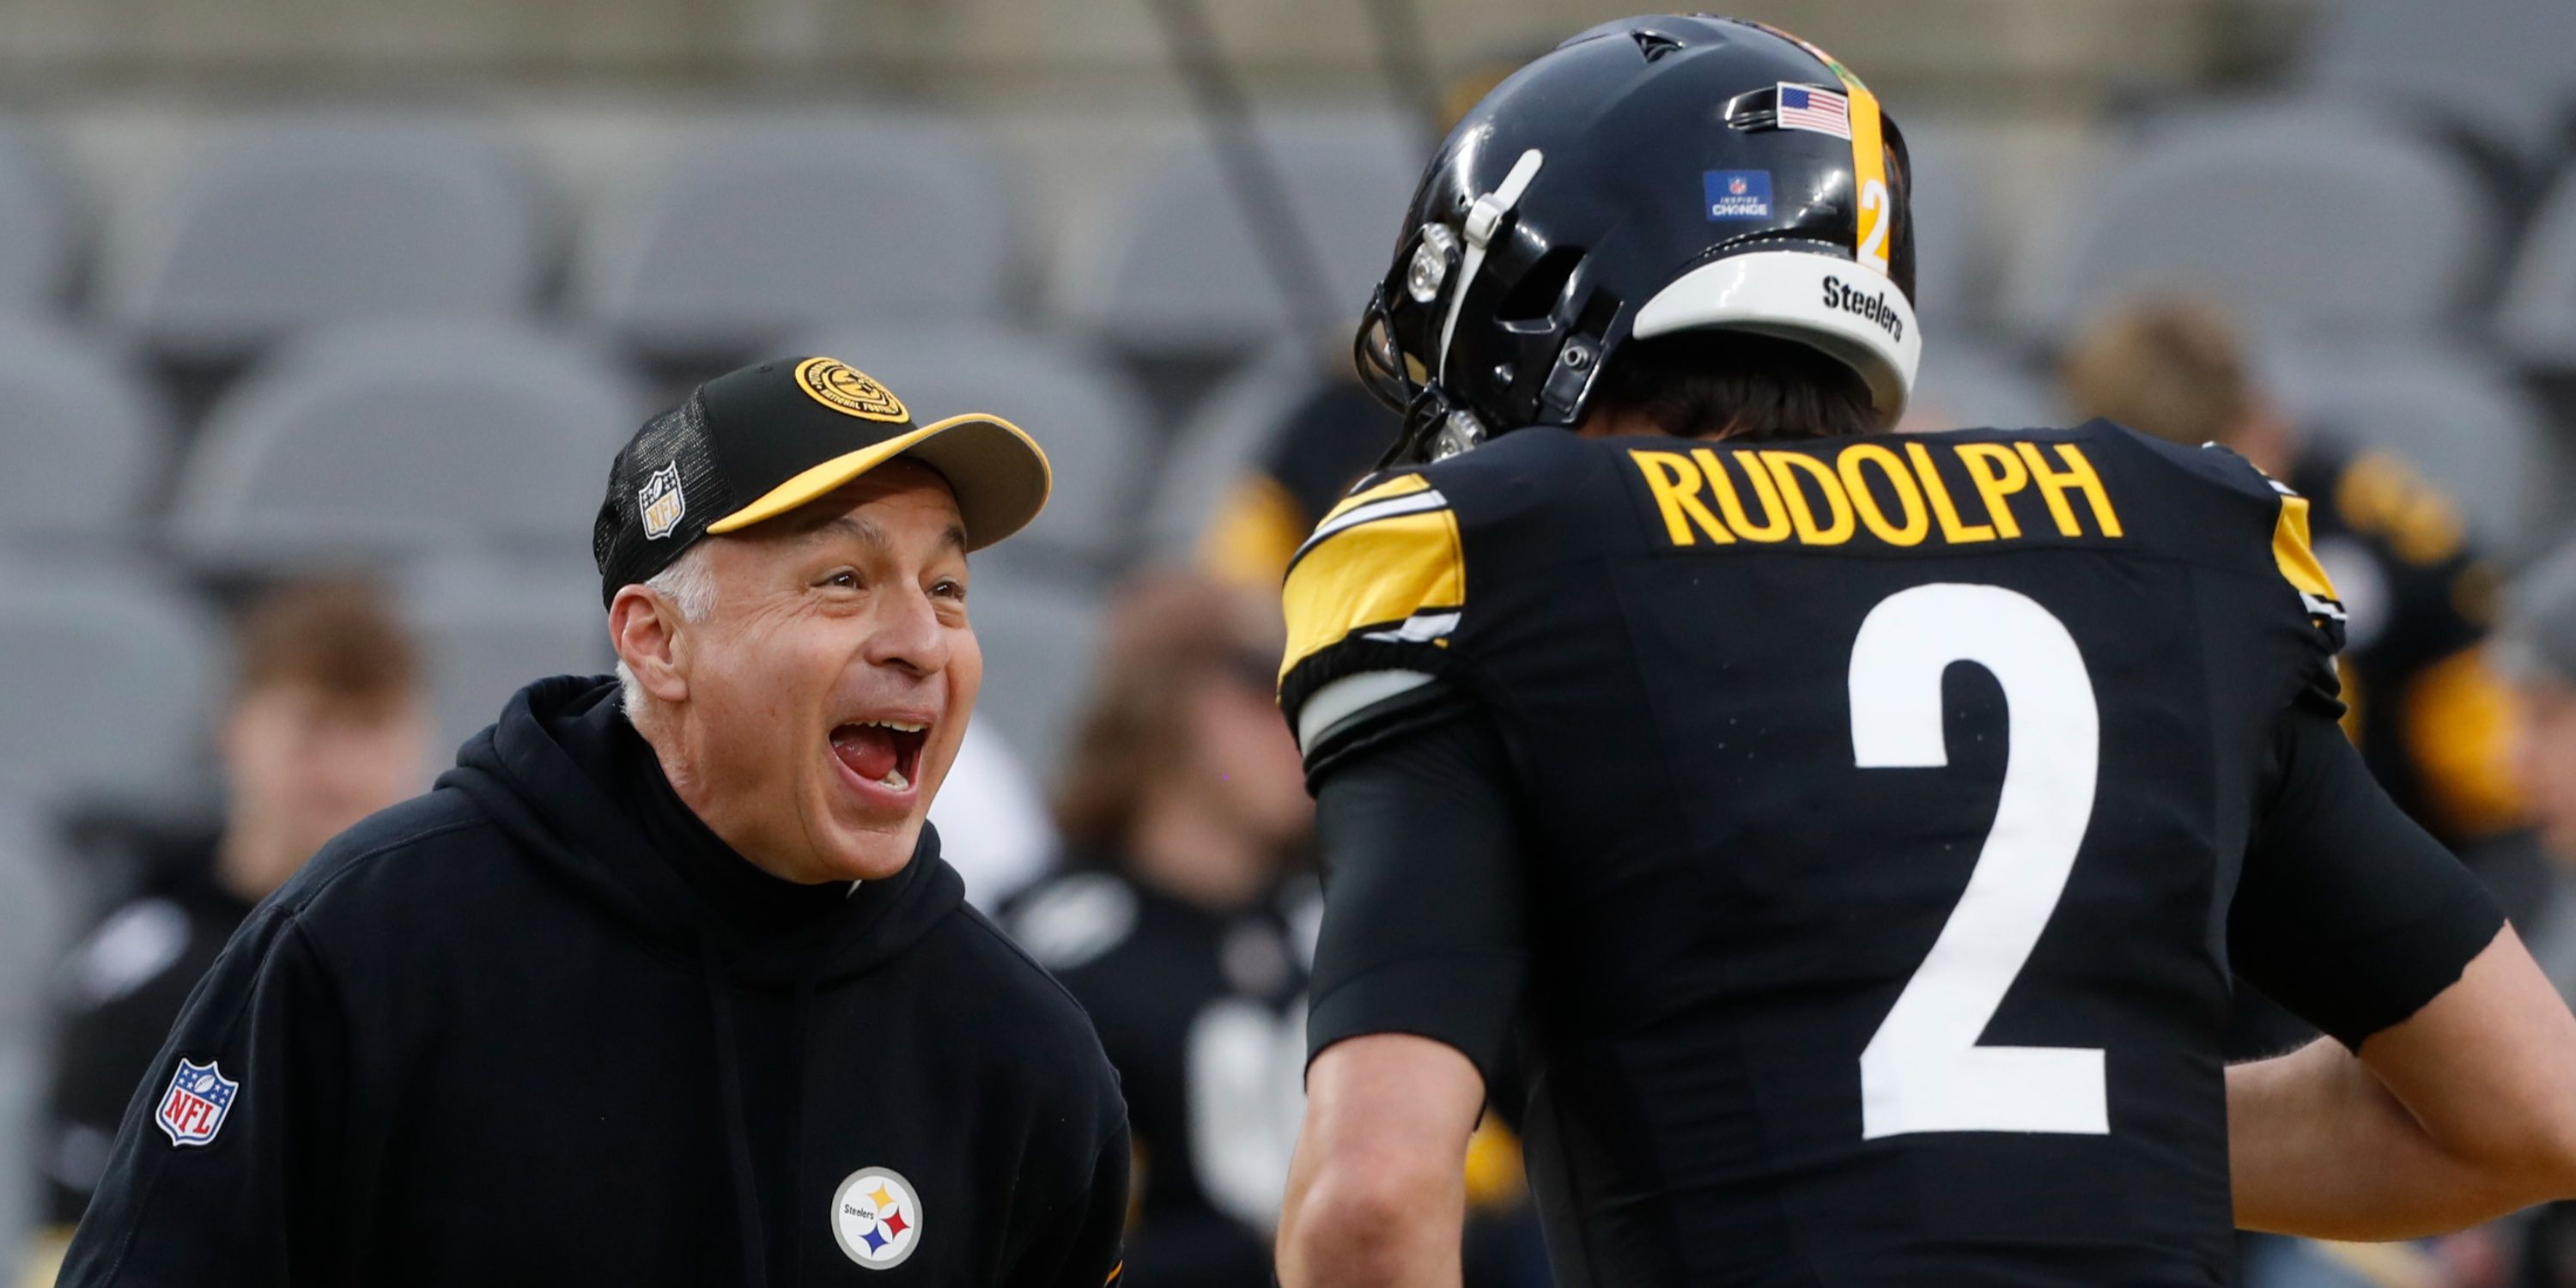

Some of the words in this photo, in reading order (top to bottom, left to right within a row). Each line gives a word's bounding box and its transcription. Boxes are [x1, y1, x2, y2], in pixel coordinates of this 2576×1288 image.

[1712, 204, 1767, 216] CHANGE
[1720, 196, 1758, 204] INSPIRE
[1856, 179, 1890, 277] 2
[1822, 275, 1903, 343] Steelers
[648, 495, 679, 532] NFL
[1628, 440, 2123, 547] RUDOLPH
[1848, 582, 2110, 1139] 2
[164, 1089, 214, 1134] NFL
[844, 1204, 874, 1220] Steelers
